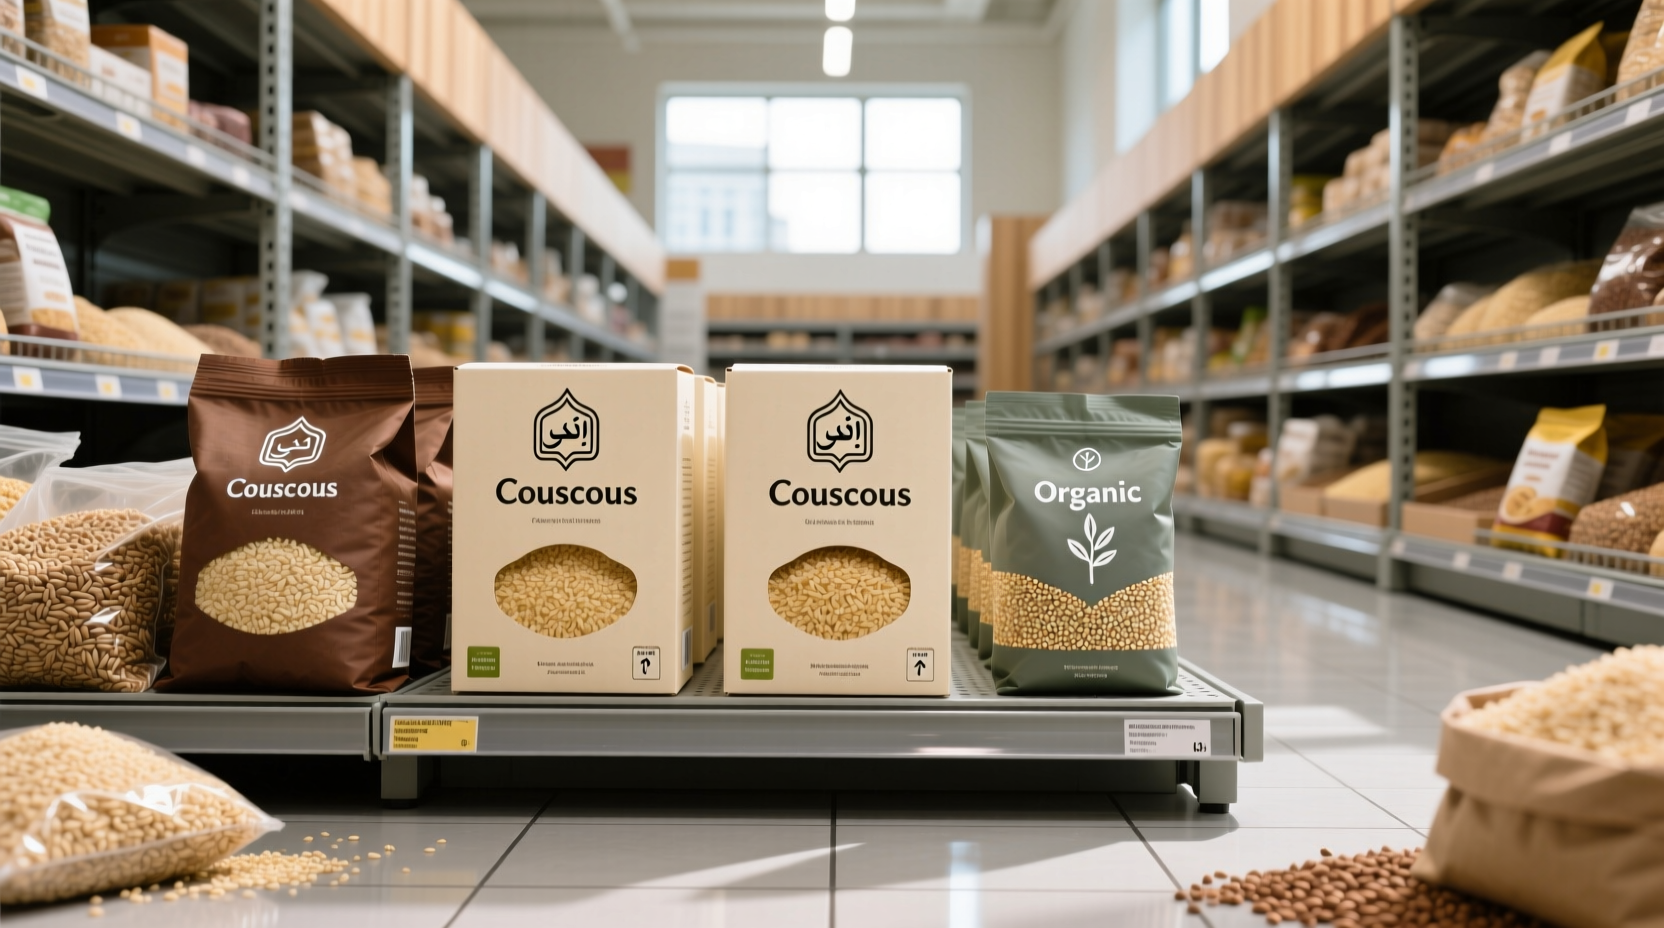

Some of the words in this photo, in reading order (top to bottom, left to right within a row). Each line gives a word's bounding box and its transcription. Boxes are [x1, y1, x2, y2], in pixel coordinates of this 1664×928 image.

[227, 478, 338, 498] Couscous
[496, 477, 637, 505] Couscous
[769, 479, 911, 507] Couscous
[1034, 480, 1142, 511] Organic
